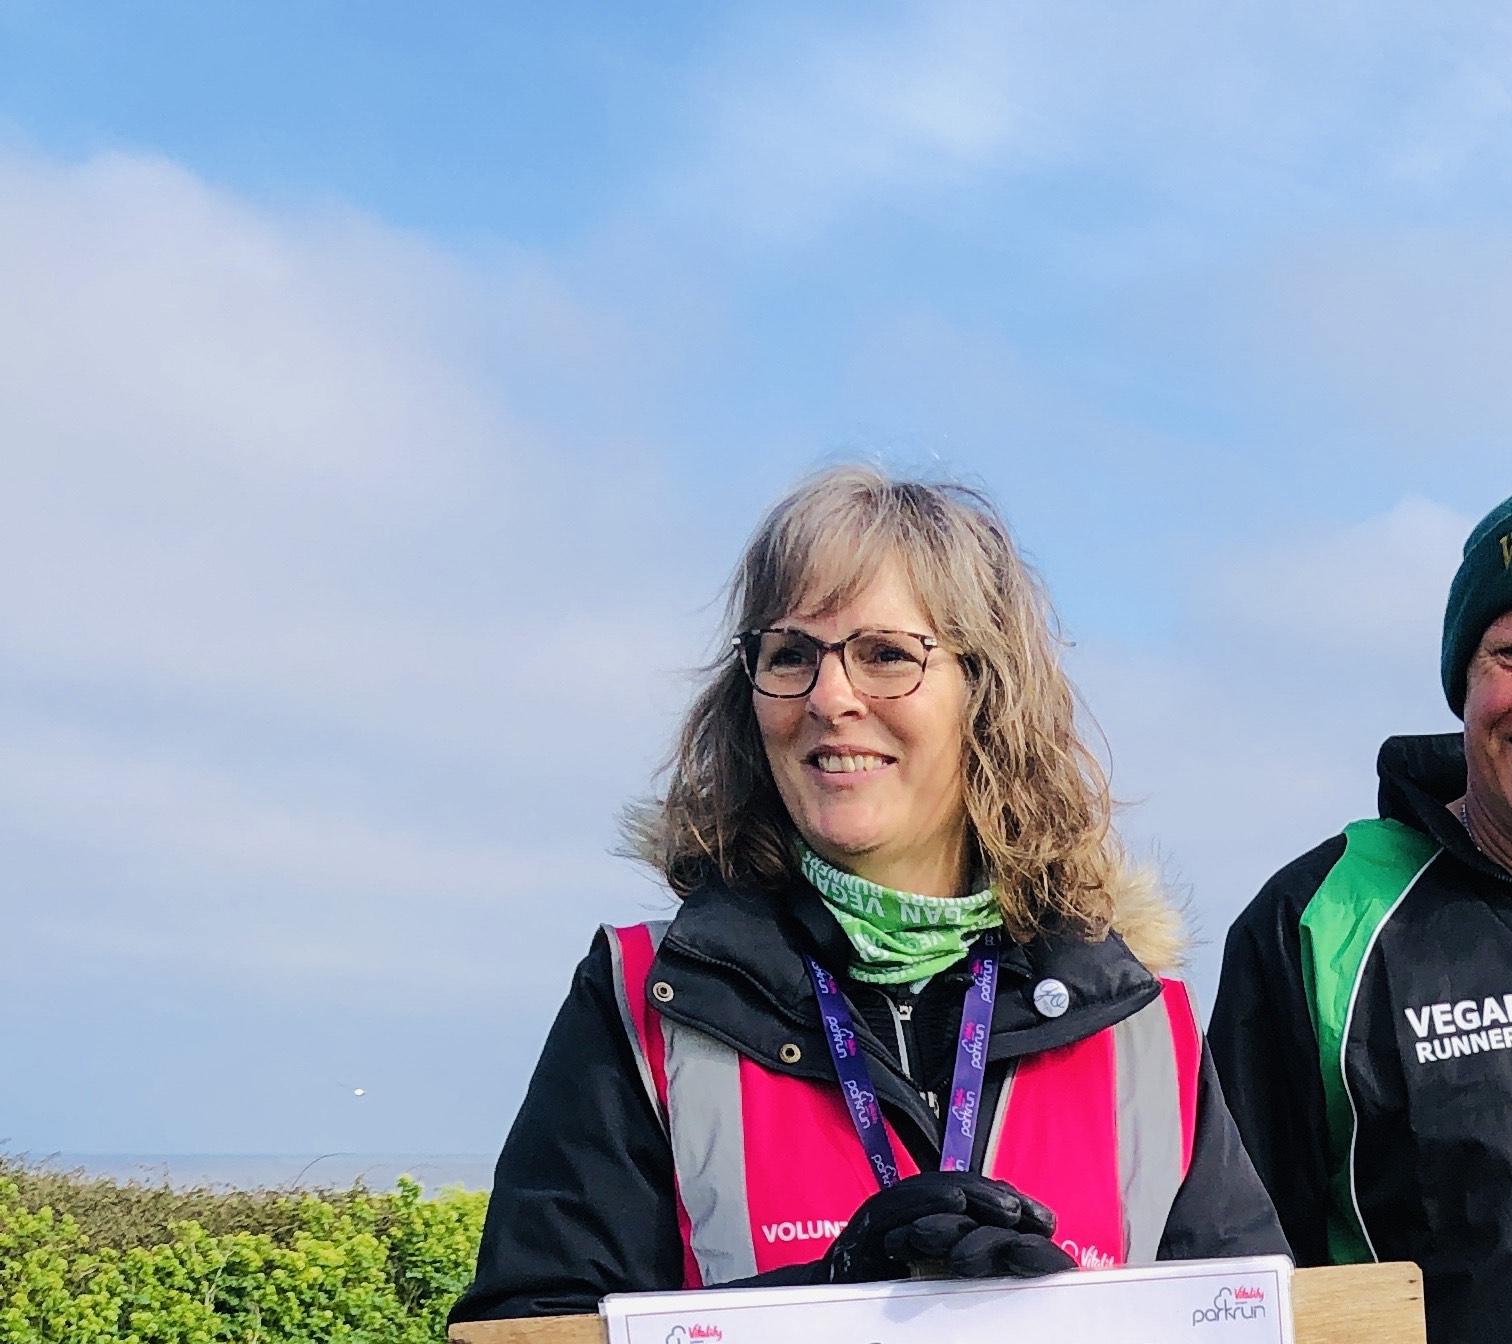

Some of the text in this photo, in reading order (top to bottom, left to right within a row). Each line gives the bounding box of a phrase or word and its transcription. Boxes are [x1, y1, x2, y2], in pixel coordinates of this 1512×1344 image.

[978, 959, 993, 1004] parkrun
[826, 1015, 849, 1059] parkrun
[967, 1023, 986, 1070] parkrun
[844, 1079, 872, 1130] parkrun
[957, 1090, 976, 1138] parkrun
[761, 1219, 849, 1244] VOLUN
[1192, 1297, 1266, 1327] parkrun
[1234, 1285, 1265, 1303] Vitality
[688, 1323, 723, 1342] Vitality
